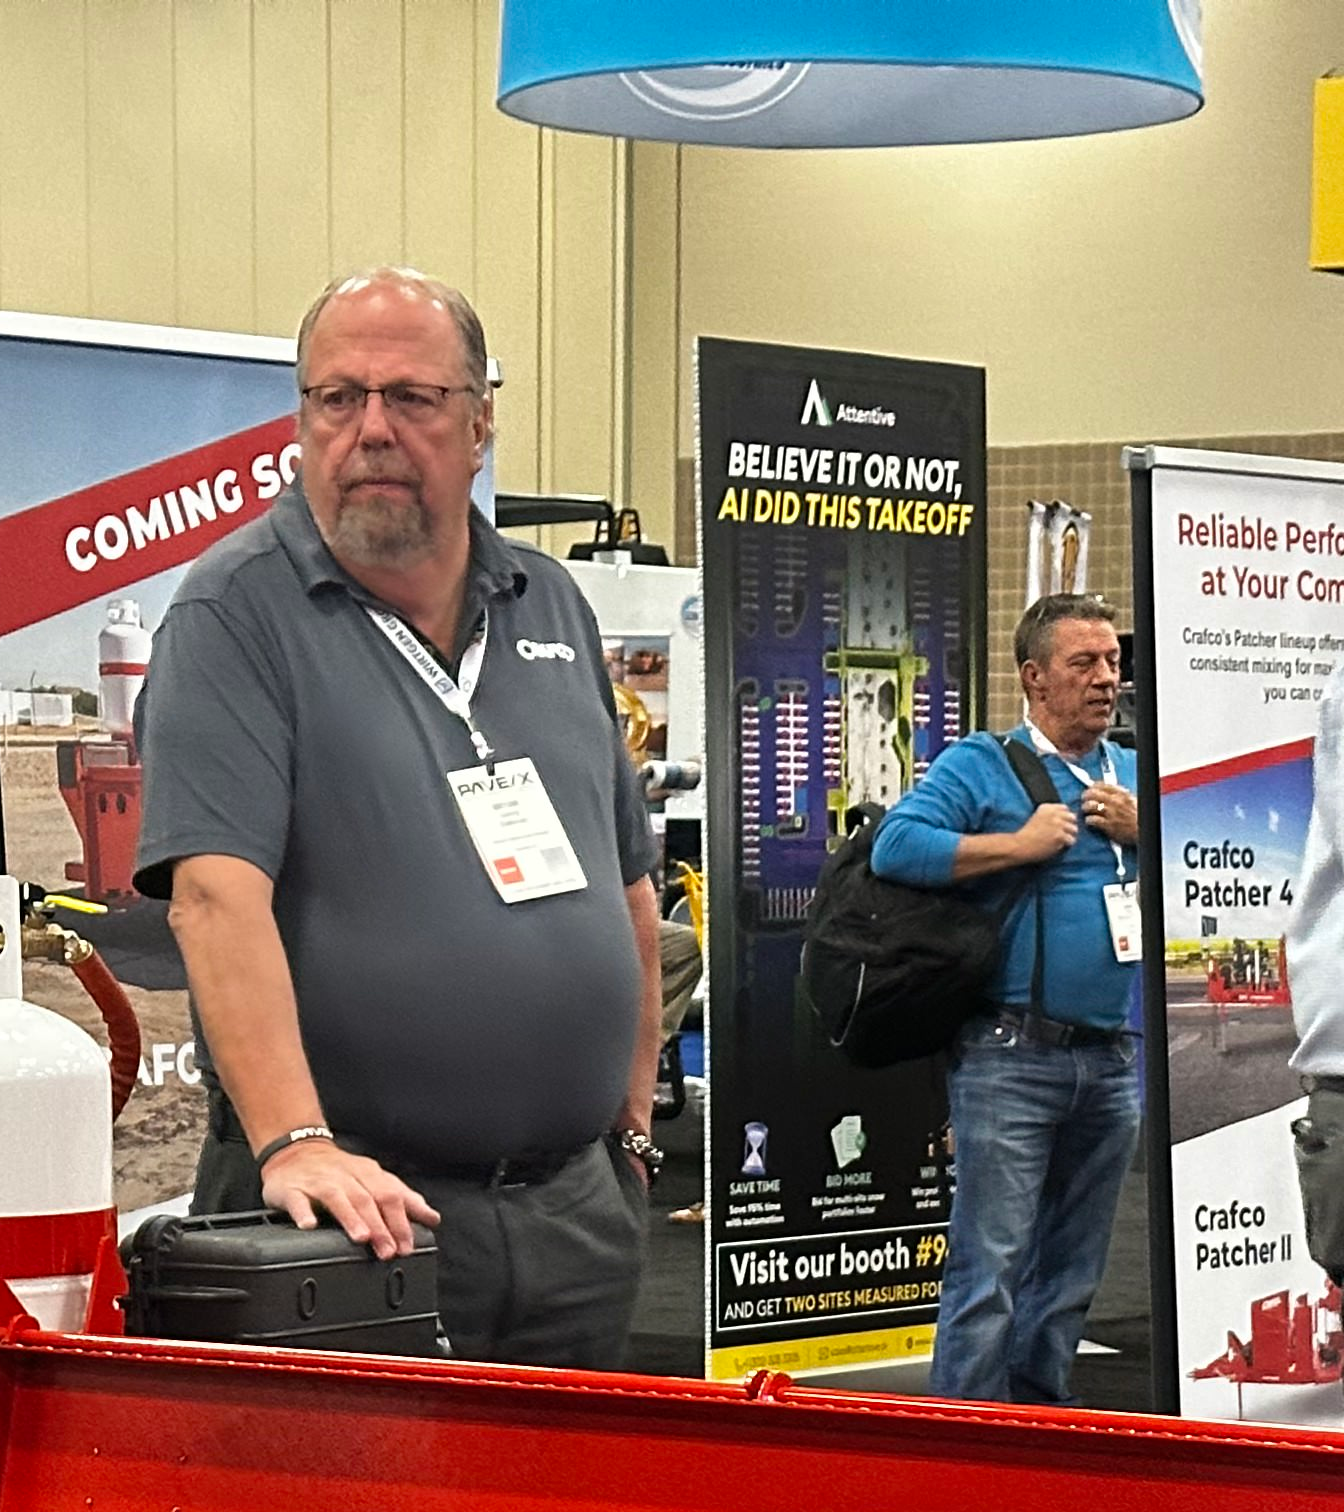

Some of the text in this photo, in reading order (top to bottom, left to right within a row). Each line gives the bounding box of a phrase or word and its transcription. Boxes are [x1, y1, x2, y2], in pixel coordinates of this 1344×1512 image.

[836, 403, 896, 427] Attentive
[728, 442, 962, 500] BELIEVE IT OR NOT,
[65, 469, 244, 572] COMING
[717, 487, 974, 536] AI DID THIS TAKEOFF
[1178, 513, 1278, 551] Reliable
[1201, 566, 1227, 597] at
[1233, 565, 1289, 600] Your
[1183, 627, 1231, 647] Crafco's
[1234, 629, 1277, 649] Patcher
[1280, 632, 1316, 653] lineup
[1190, 655, 1249, 673] consistent
[1252, 657, 1292, 678] mixing
[1295, 657, 1312, 674] for
[1263, 686, 1286, 704] you
[1290, 686, 1311, 700] can
[1183, 840, 1254, 869] Crafco
[1184, 878, 1293, 908] Patcher 4
[729, 1179, 781, 1196] SAVE TIME
[844, 1171, 872, 1186] MORE
[1195, 1200, 1265, 1232] Crafco
[730, 1234, 950, 1286] Visit our booth #9
[1196, 1234, 1292, 1270] Patcher II
[724, 1301, 754, 1320] AND
[757, 1298, 782, 1317] GET
[785, 1295, 816, 1314] TWO
[818, 1290, 852, 1310] SITES
[854, 1285, 919, 1307] MEASURED
